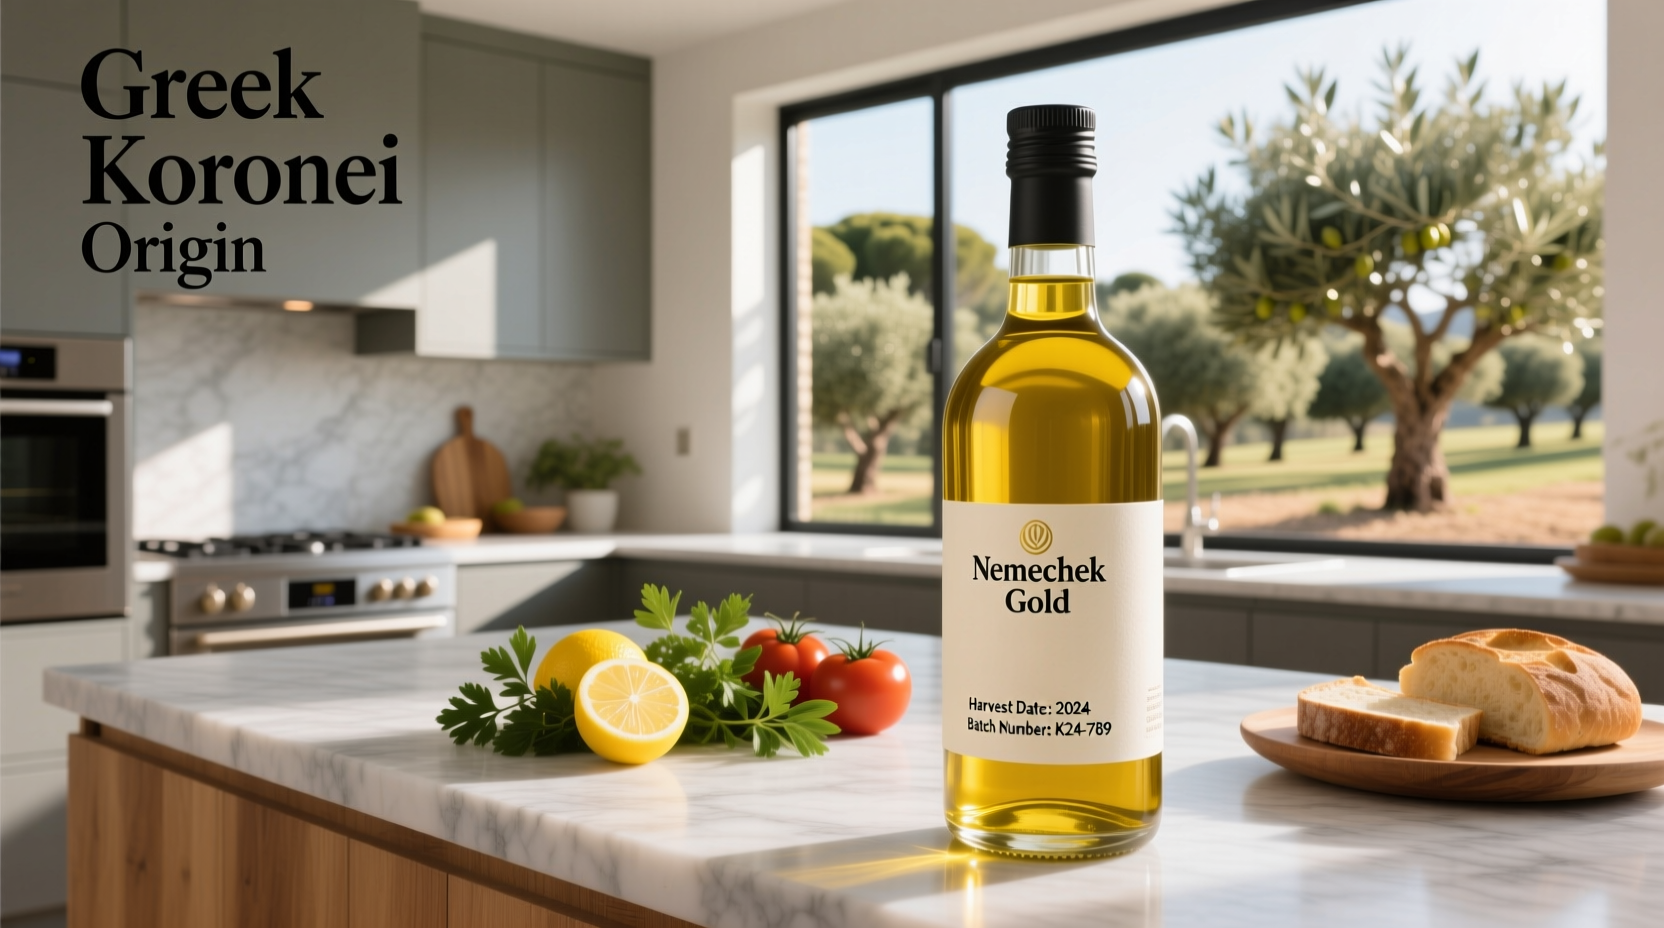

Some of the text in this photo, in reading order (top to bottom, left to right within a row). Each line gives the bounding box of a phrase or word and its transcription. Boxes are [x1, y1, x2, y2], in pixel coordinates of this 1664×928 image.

[972, 555, 1106, 582] Nemechek
[1005, 588, 1071, 613] Gold
[968, 697, 1091, 715] Harvest Date: 2024
[967, 717, 996, 733] Batch
